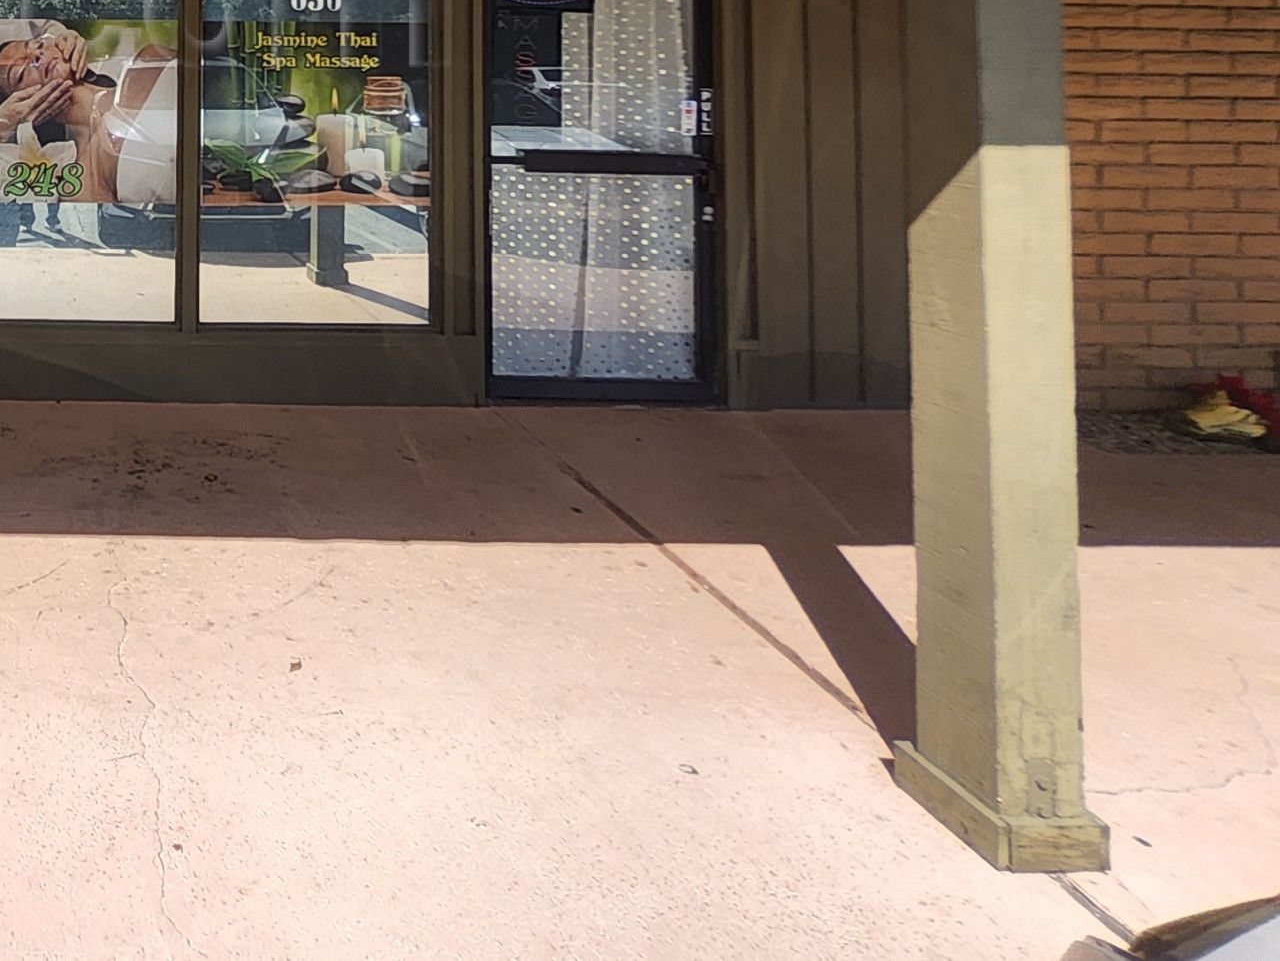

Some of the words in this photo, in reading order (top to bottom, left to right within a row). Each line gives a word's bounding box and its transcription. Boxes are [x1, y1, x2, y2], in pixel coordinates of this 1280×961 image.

[253, 31, 329, 50] Jasmine
[335, 32, 379, 49] Thai
[261, 52, 297, 72] Spa
[304, 52, 381, 73] Massage
